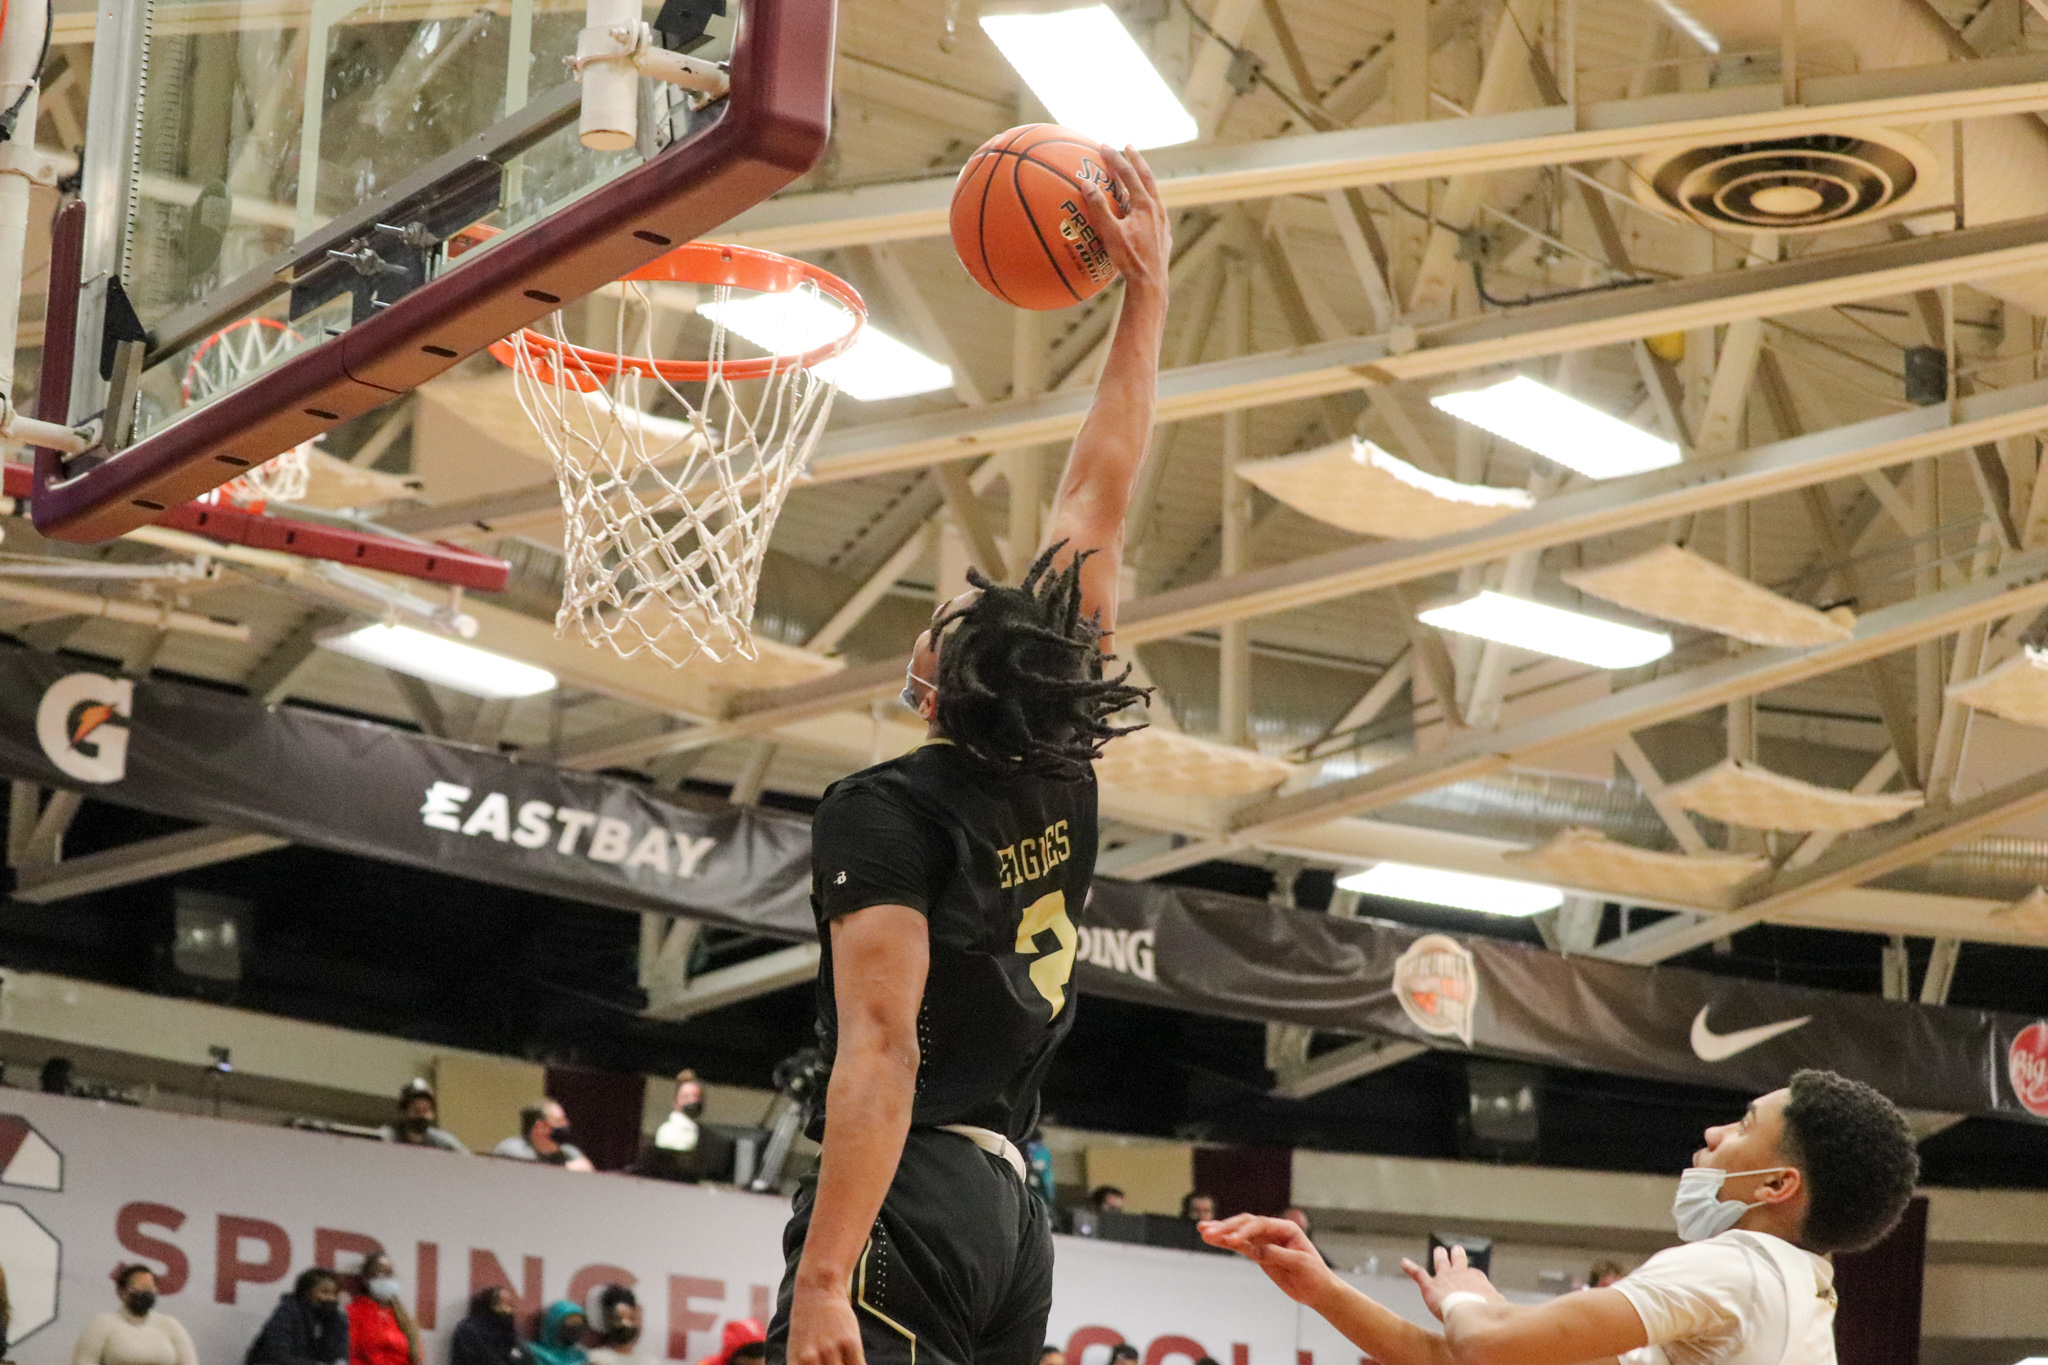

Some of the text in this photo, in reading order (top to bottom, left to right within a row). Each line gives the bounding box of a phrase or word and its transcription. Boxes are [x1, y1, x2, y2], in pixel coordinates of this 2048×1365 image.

[37, 671, 134, 784] G
[420, 780, 717, 879] EASTBAY
[1077, 925, 1157, 982] DING
[109, 1201, 771, 1363] SPRINGFI
